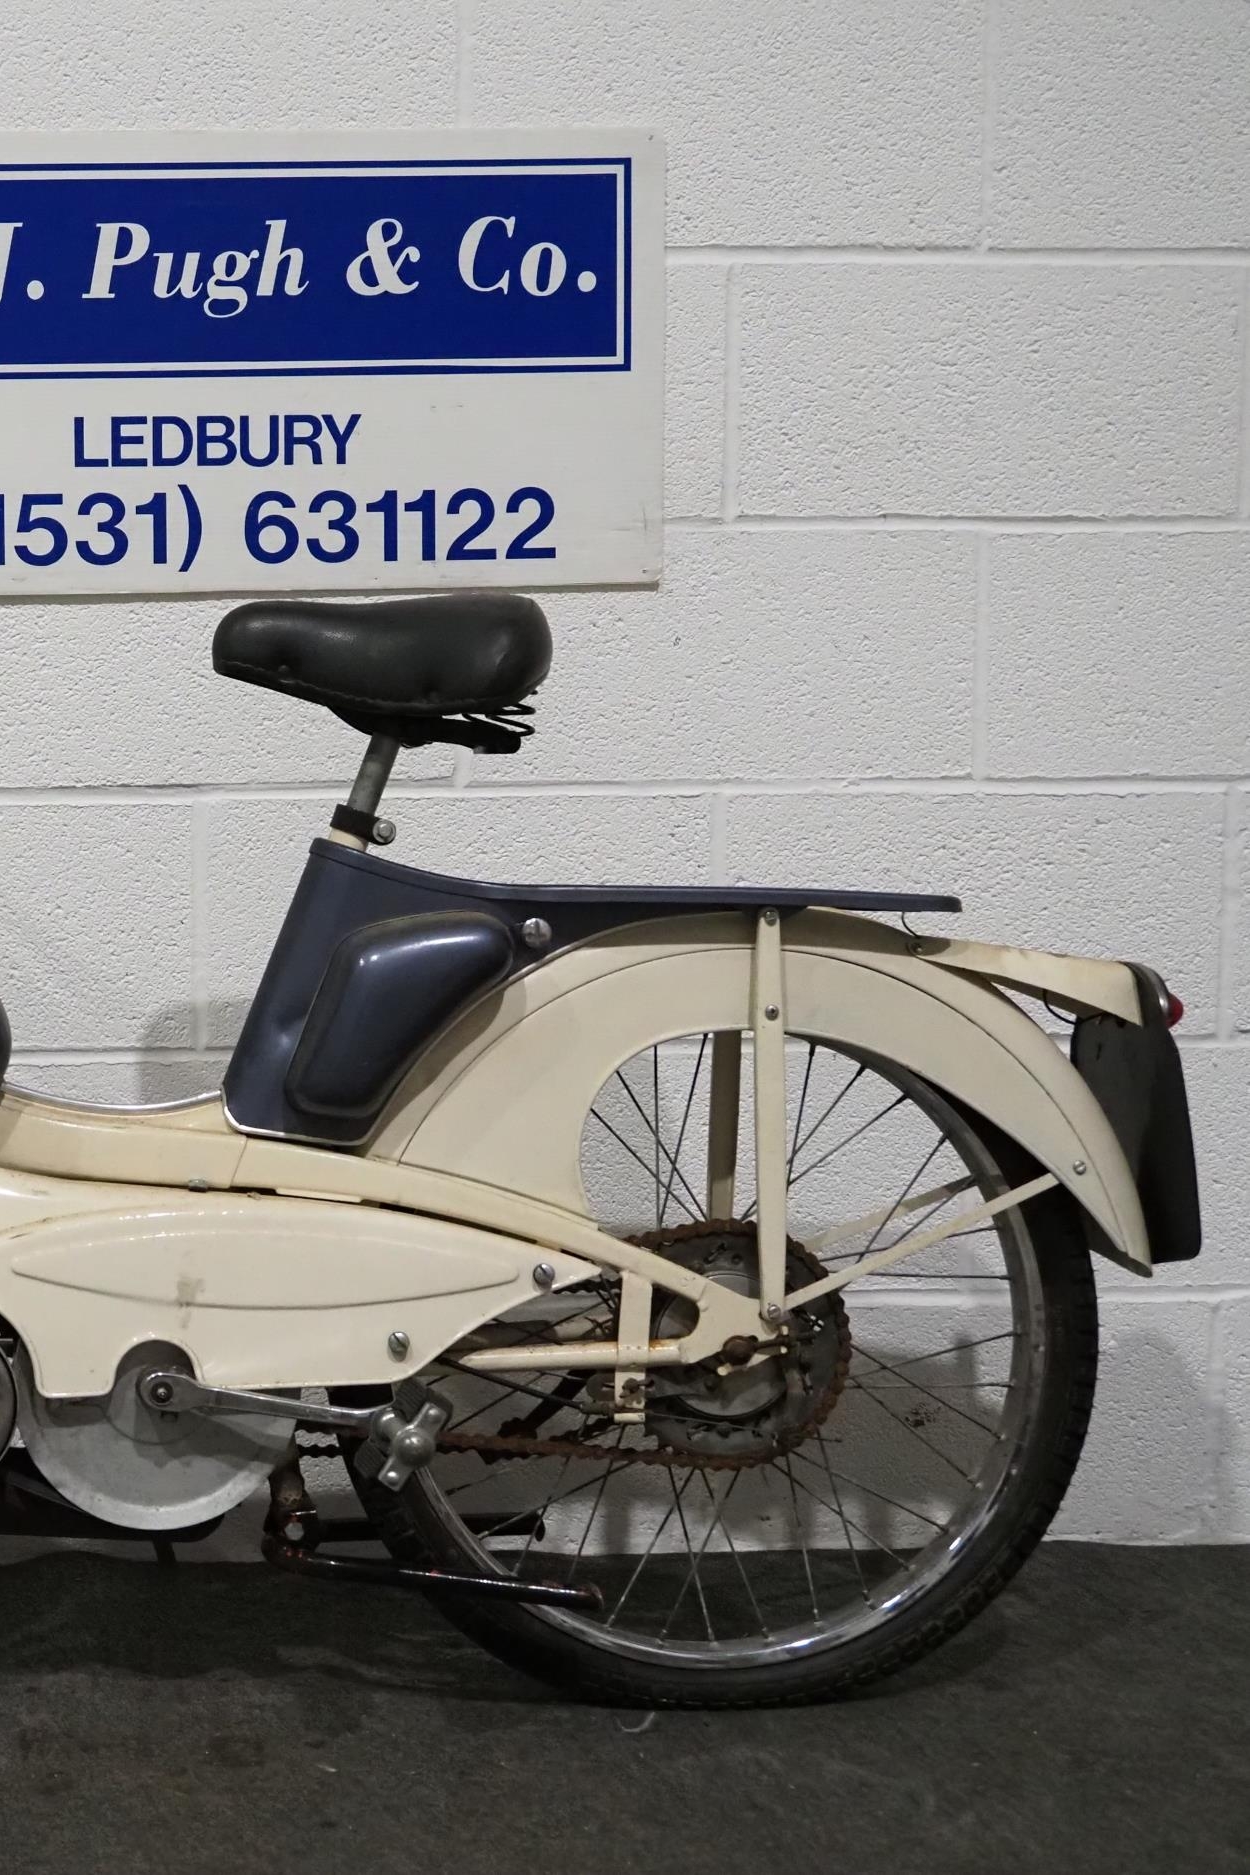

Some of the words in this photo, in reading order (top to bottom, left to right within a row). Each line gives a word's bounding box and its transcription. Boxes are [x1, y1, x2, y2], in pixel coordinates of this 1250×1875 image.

[81, 219, 310, 319] Pugh
[346, 218, 421, 296] &
[458, 215, 597, 297] Co.
[73, 413, 362, 468] LEDBURY
[244, 487, 557, 565] 631122
